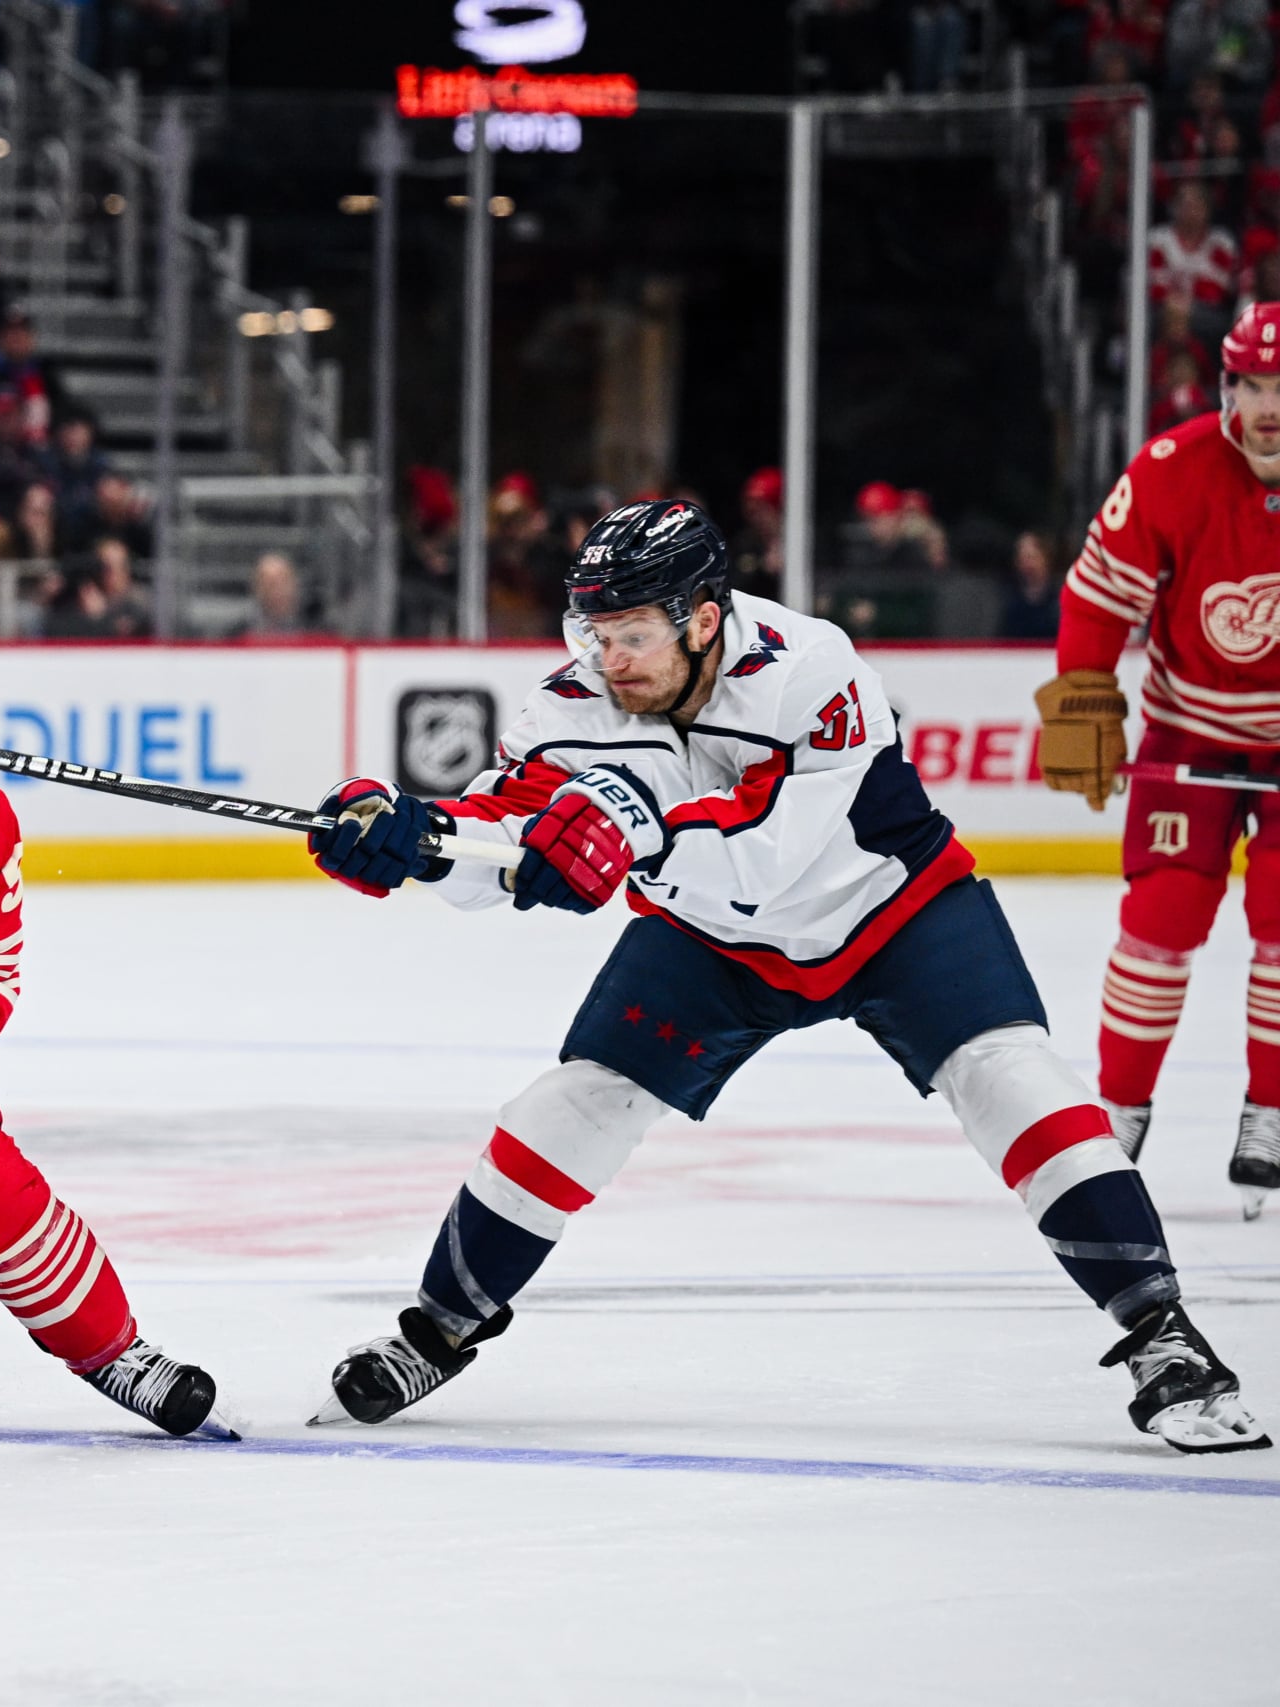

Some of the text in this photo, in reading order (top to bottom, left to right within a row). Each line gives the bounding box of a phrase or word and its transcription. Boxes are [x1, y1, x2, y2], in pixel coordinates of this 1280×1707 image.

[1261, 322, 1276, 343] 8
[1102, 473, 1132, 532] 8
[575, 772, 650, 829] UER
